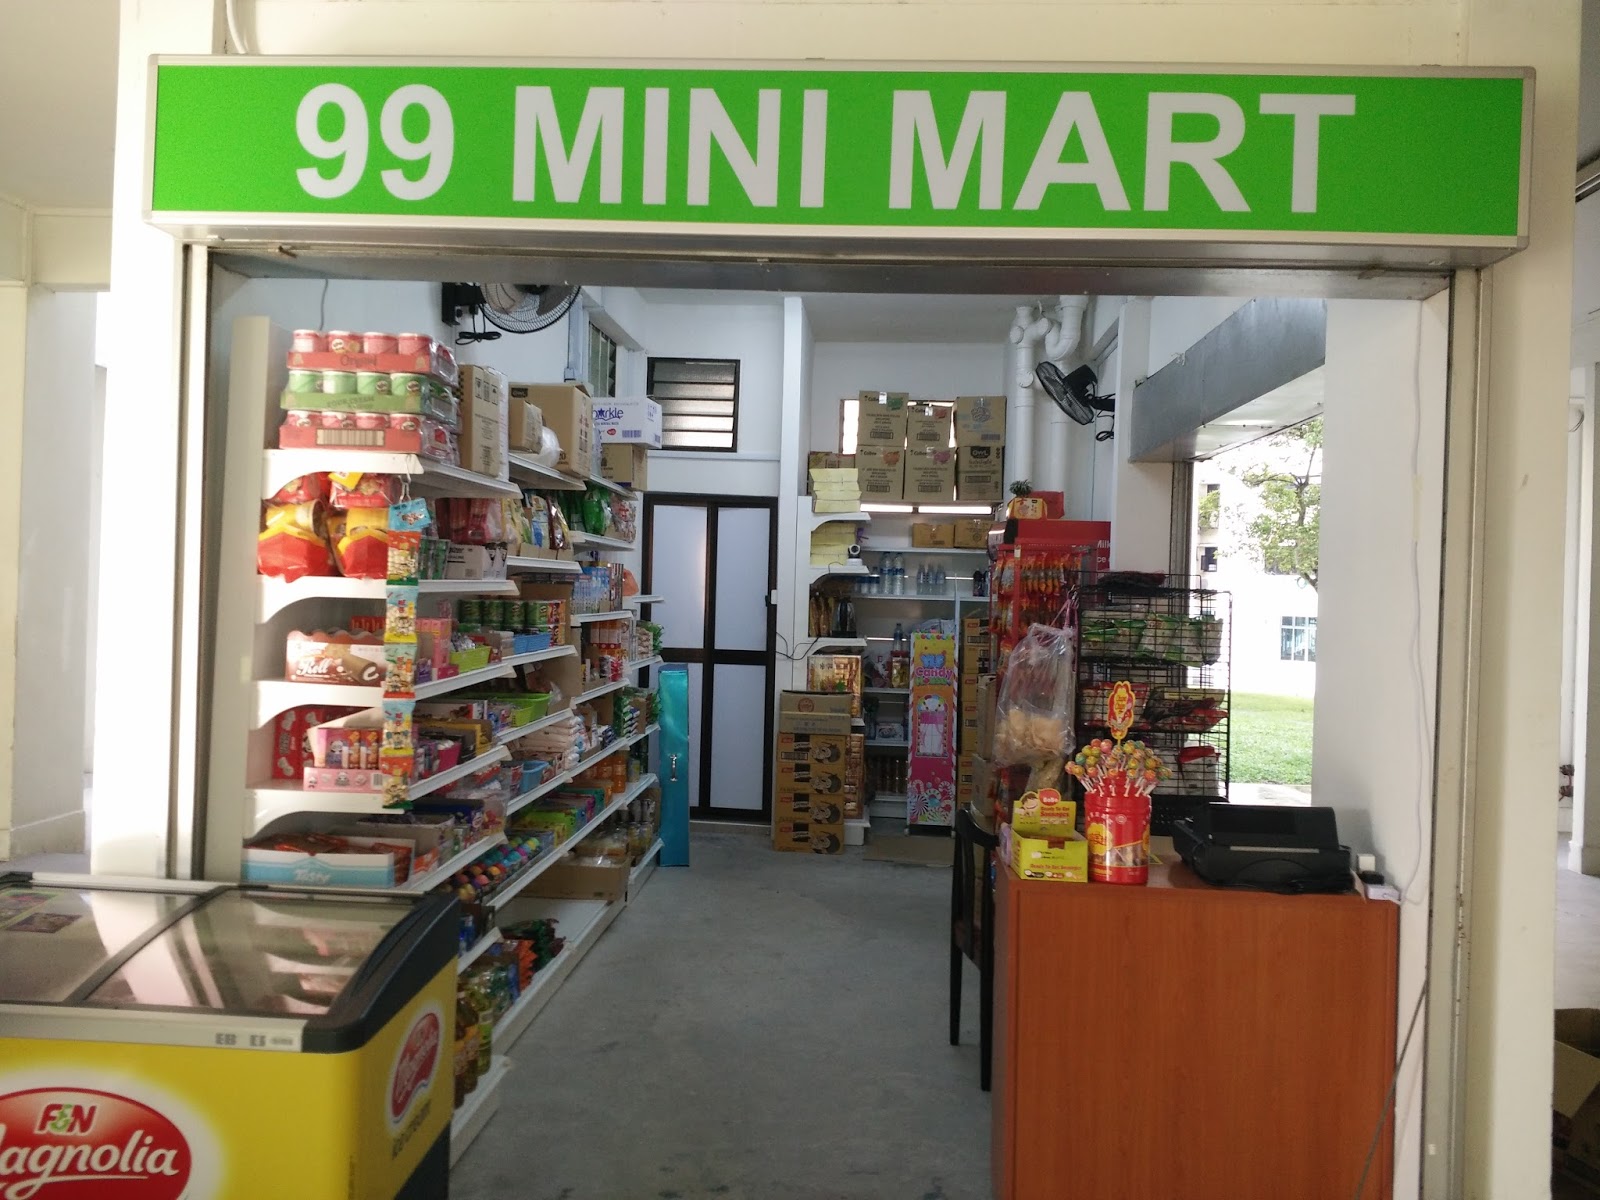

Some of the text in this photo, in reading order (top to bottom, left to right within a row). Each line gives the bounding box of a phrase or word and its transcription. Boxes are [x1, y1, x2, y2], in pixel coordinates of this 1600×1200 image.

[295, 82, 1356, 214] 99 MINI MART
[296, 657, 334, 675] Roll
[914, 665, 953, 680] Candy
[36, 1103, 97, 1134] F&N
[0, 1124, 180, 1200] agnolia
